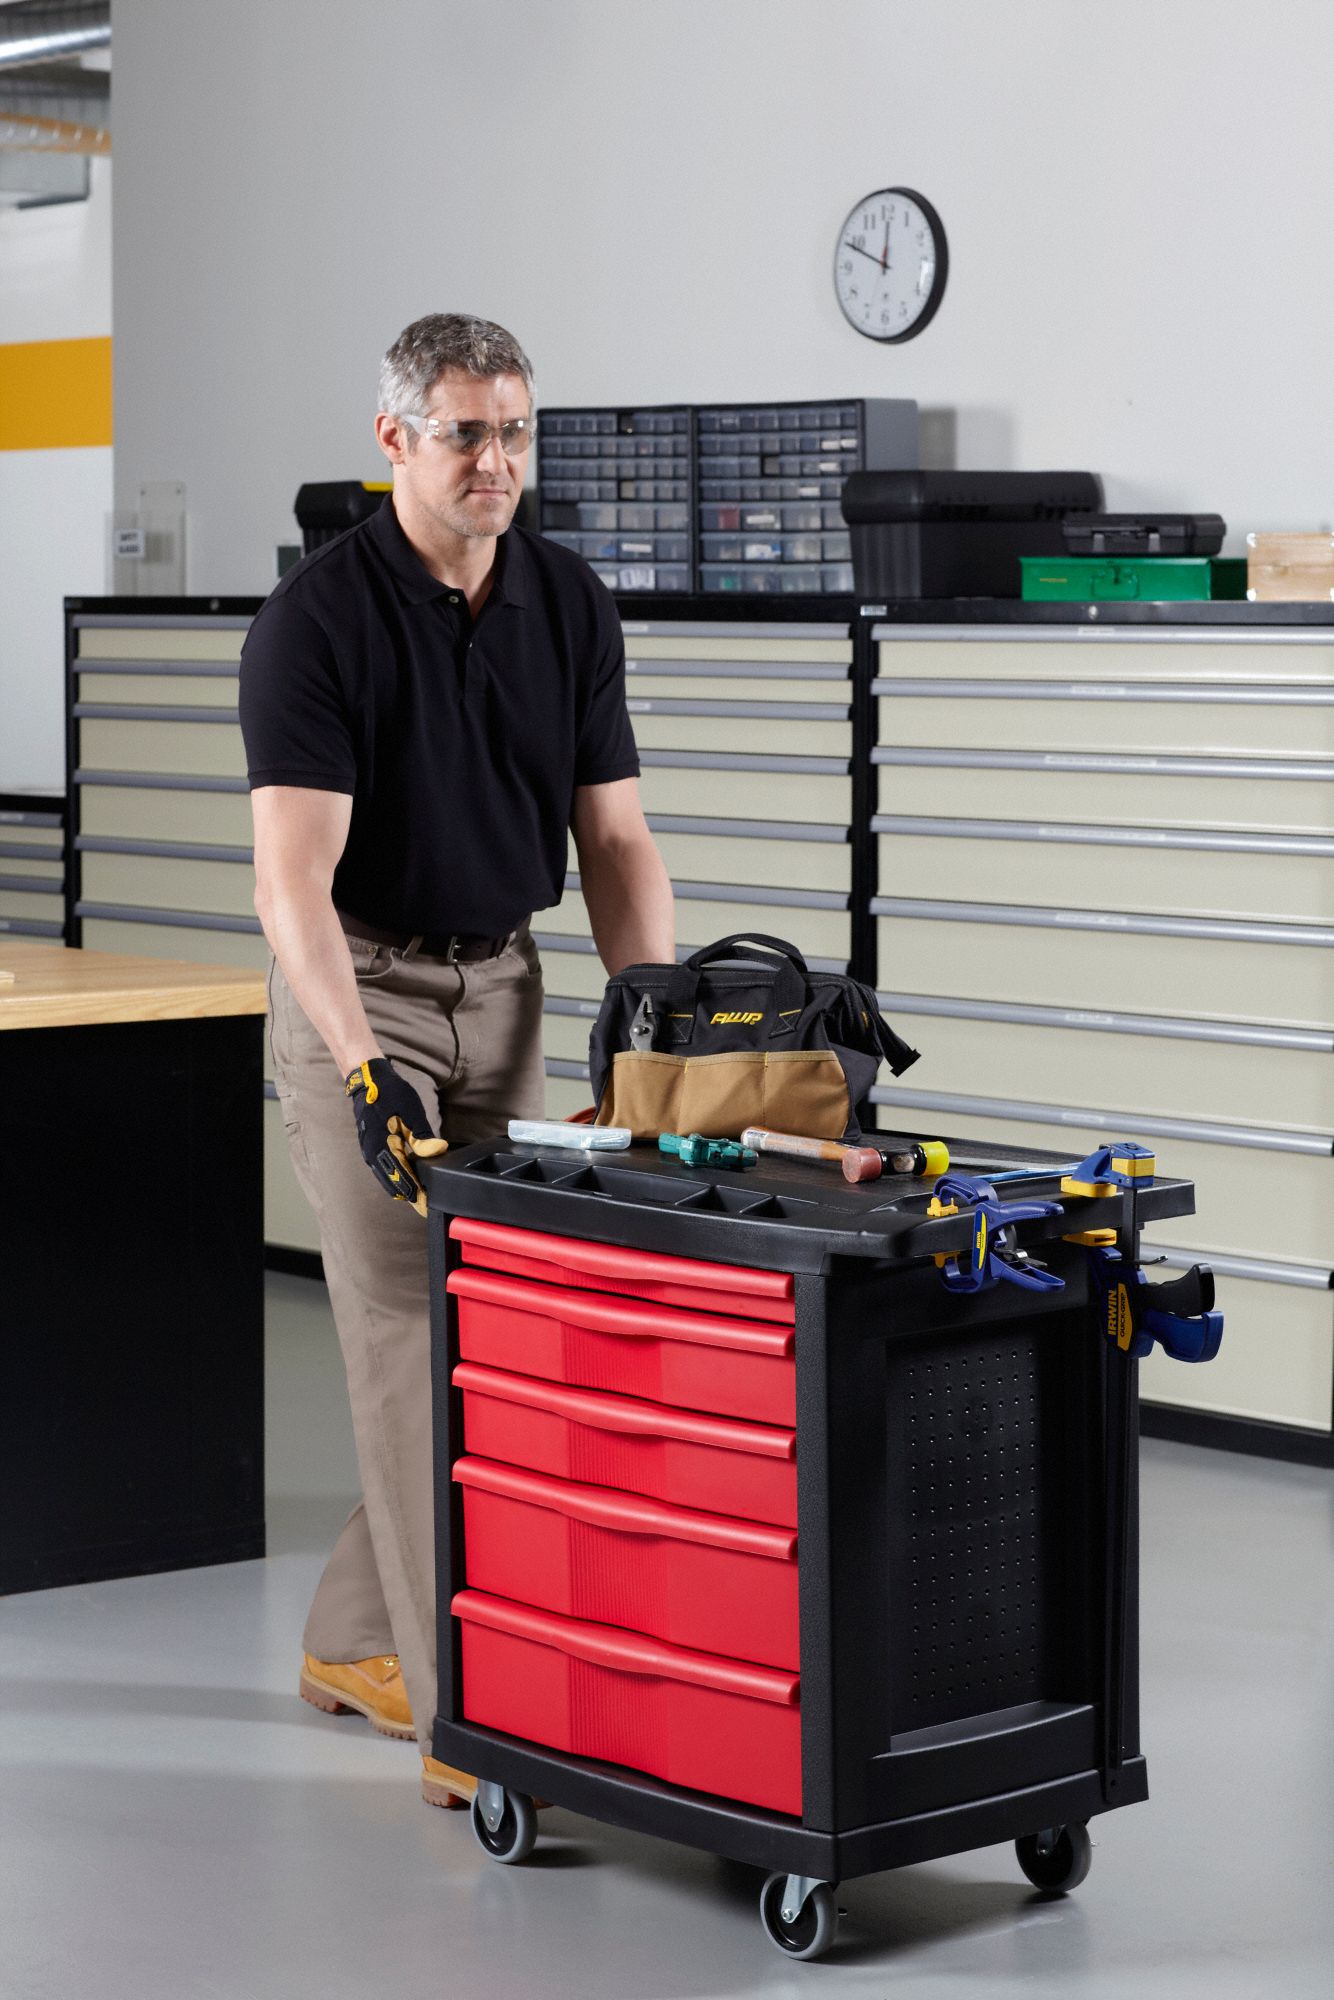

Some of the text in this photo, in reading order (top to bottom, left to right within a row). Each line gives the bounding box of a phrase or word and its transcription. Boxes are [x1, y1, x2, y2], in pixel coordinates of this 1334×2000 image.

[881, 204, 895, 221] 12
[904, 211, 909, 228] 1
[863, 213, 876, 230] 11
[710, 1012, 763, 1024] AWP
[1108, 1289, 1117, 1335] IRWIN
